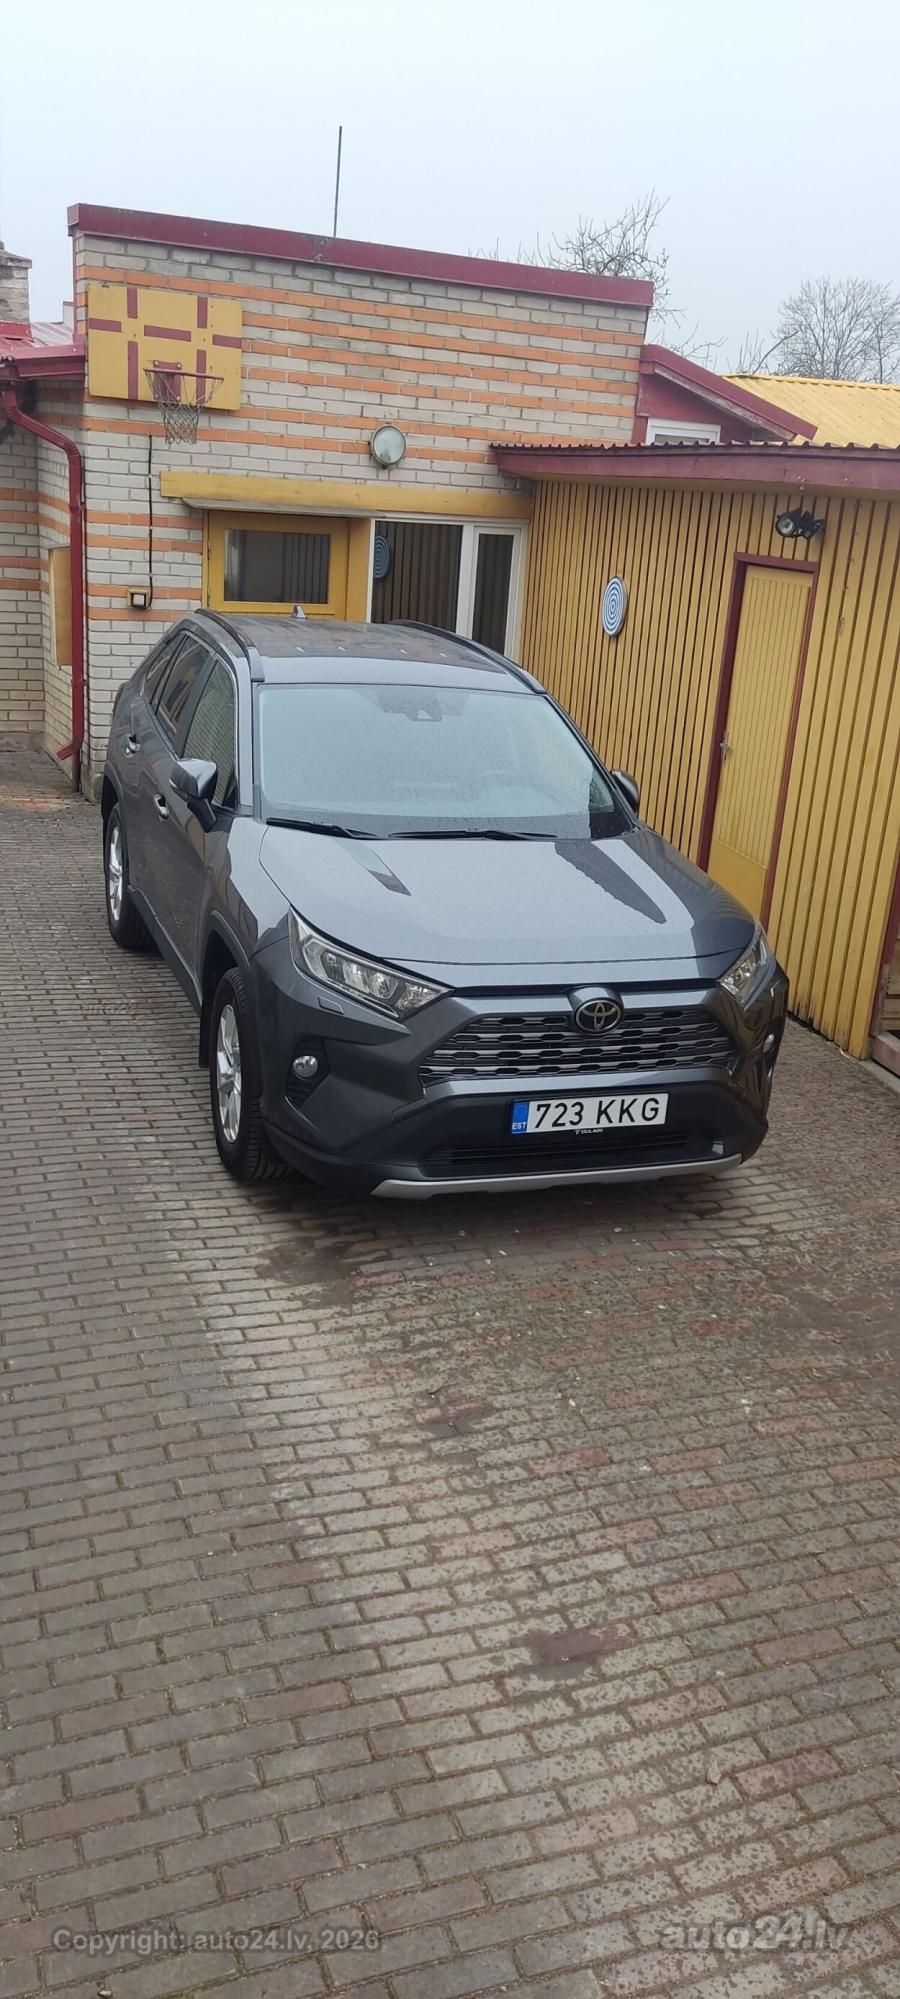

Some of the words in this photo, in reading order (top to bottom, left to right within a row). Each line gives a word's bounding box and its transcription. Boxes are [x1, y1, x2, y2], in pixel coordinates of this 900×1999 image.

[535, 1102, 584, 1129] 723
[596, 1098, 660, 1125] KKG
[511, 1121, 528, 1130] EST
